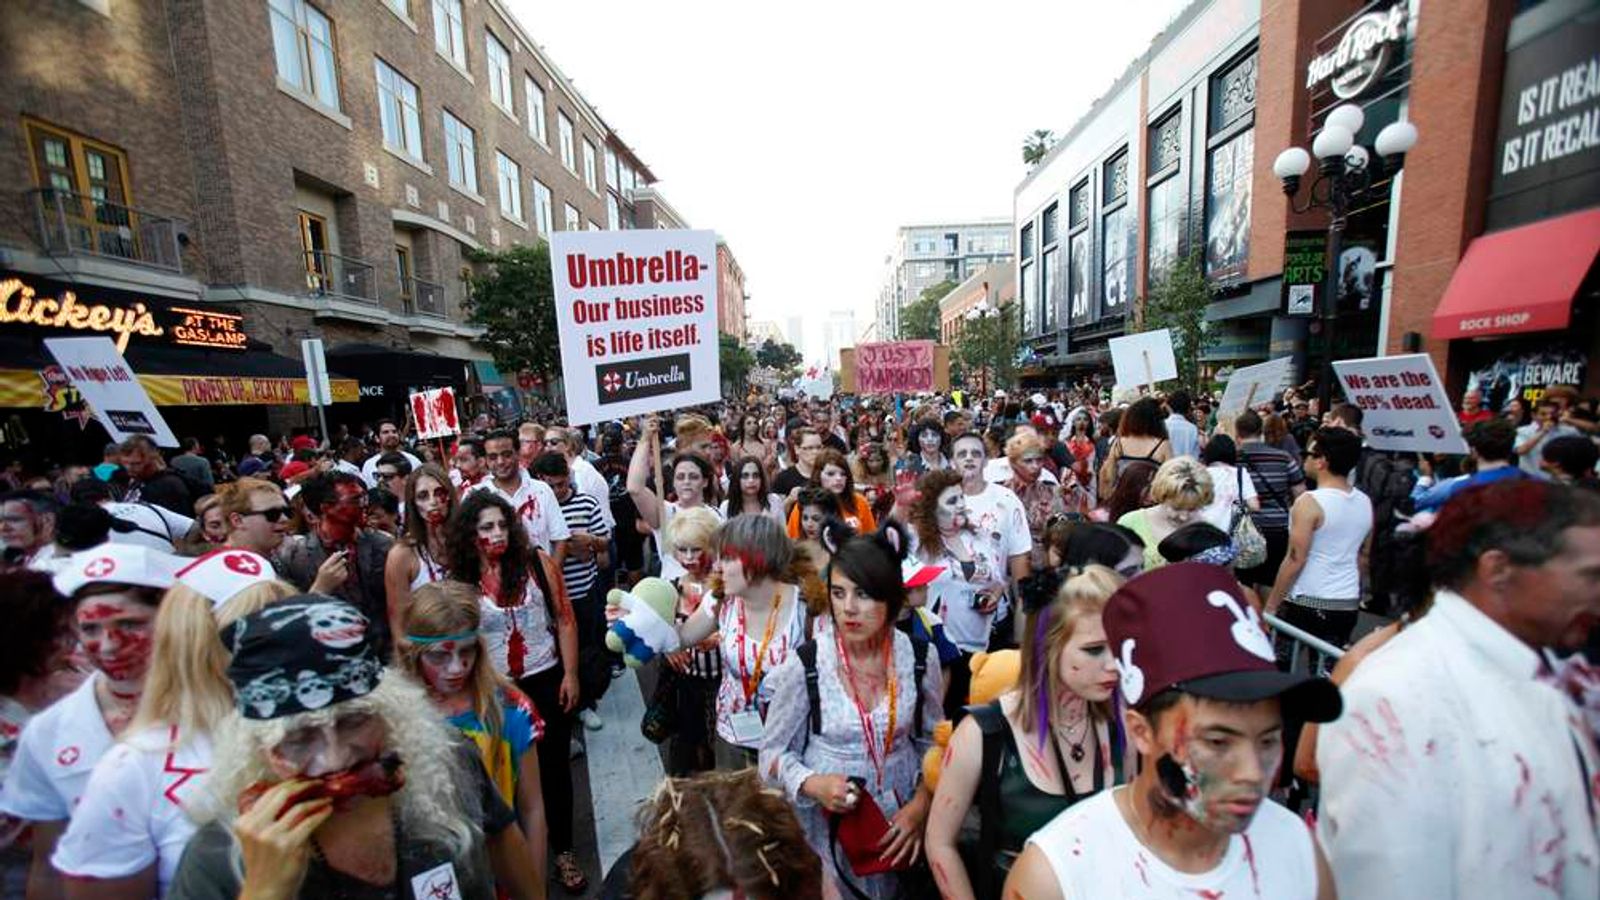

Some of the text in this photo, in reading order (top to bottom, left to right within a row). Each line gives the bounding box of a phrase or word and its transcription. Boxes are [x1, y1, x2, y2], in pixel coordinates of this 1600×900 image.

[1306, 4, 1403, 89] Hard Rock
[1517, 85, 1538, 126] IS
[1539, 76, 1559, 117] IT
[1502, 137, 1522, 175] IS
[1522, 130, 1542, 168] IT
[566, 249, 709, 290] Umbrella-
[1282, 265, 1324, 284] ARTS
[572, 293, 705, 325] Our business
[185, 315, 236, 332] AT THE
[1460, 312, 1531, 331] ROCK SHOP
[174, 325, 247, 344] GASLAMP
[586, 323, 701, 358] is life itself.
[624, 365, 685, 389] Umbrella
[1344, 370, 1432, 389] We are the
[1523, 362, 1582, 385] BEWARE
[1356, 393, 1441, 410] 99% dead.
